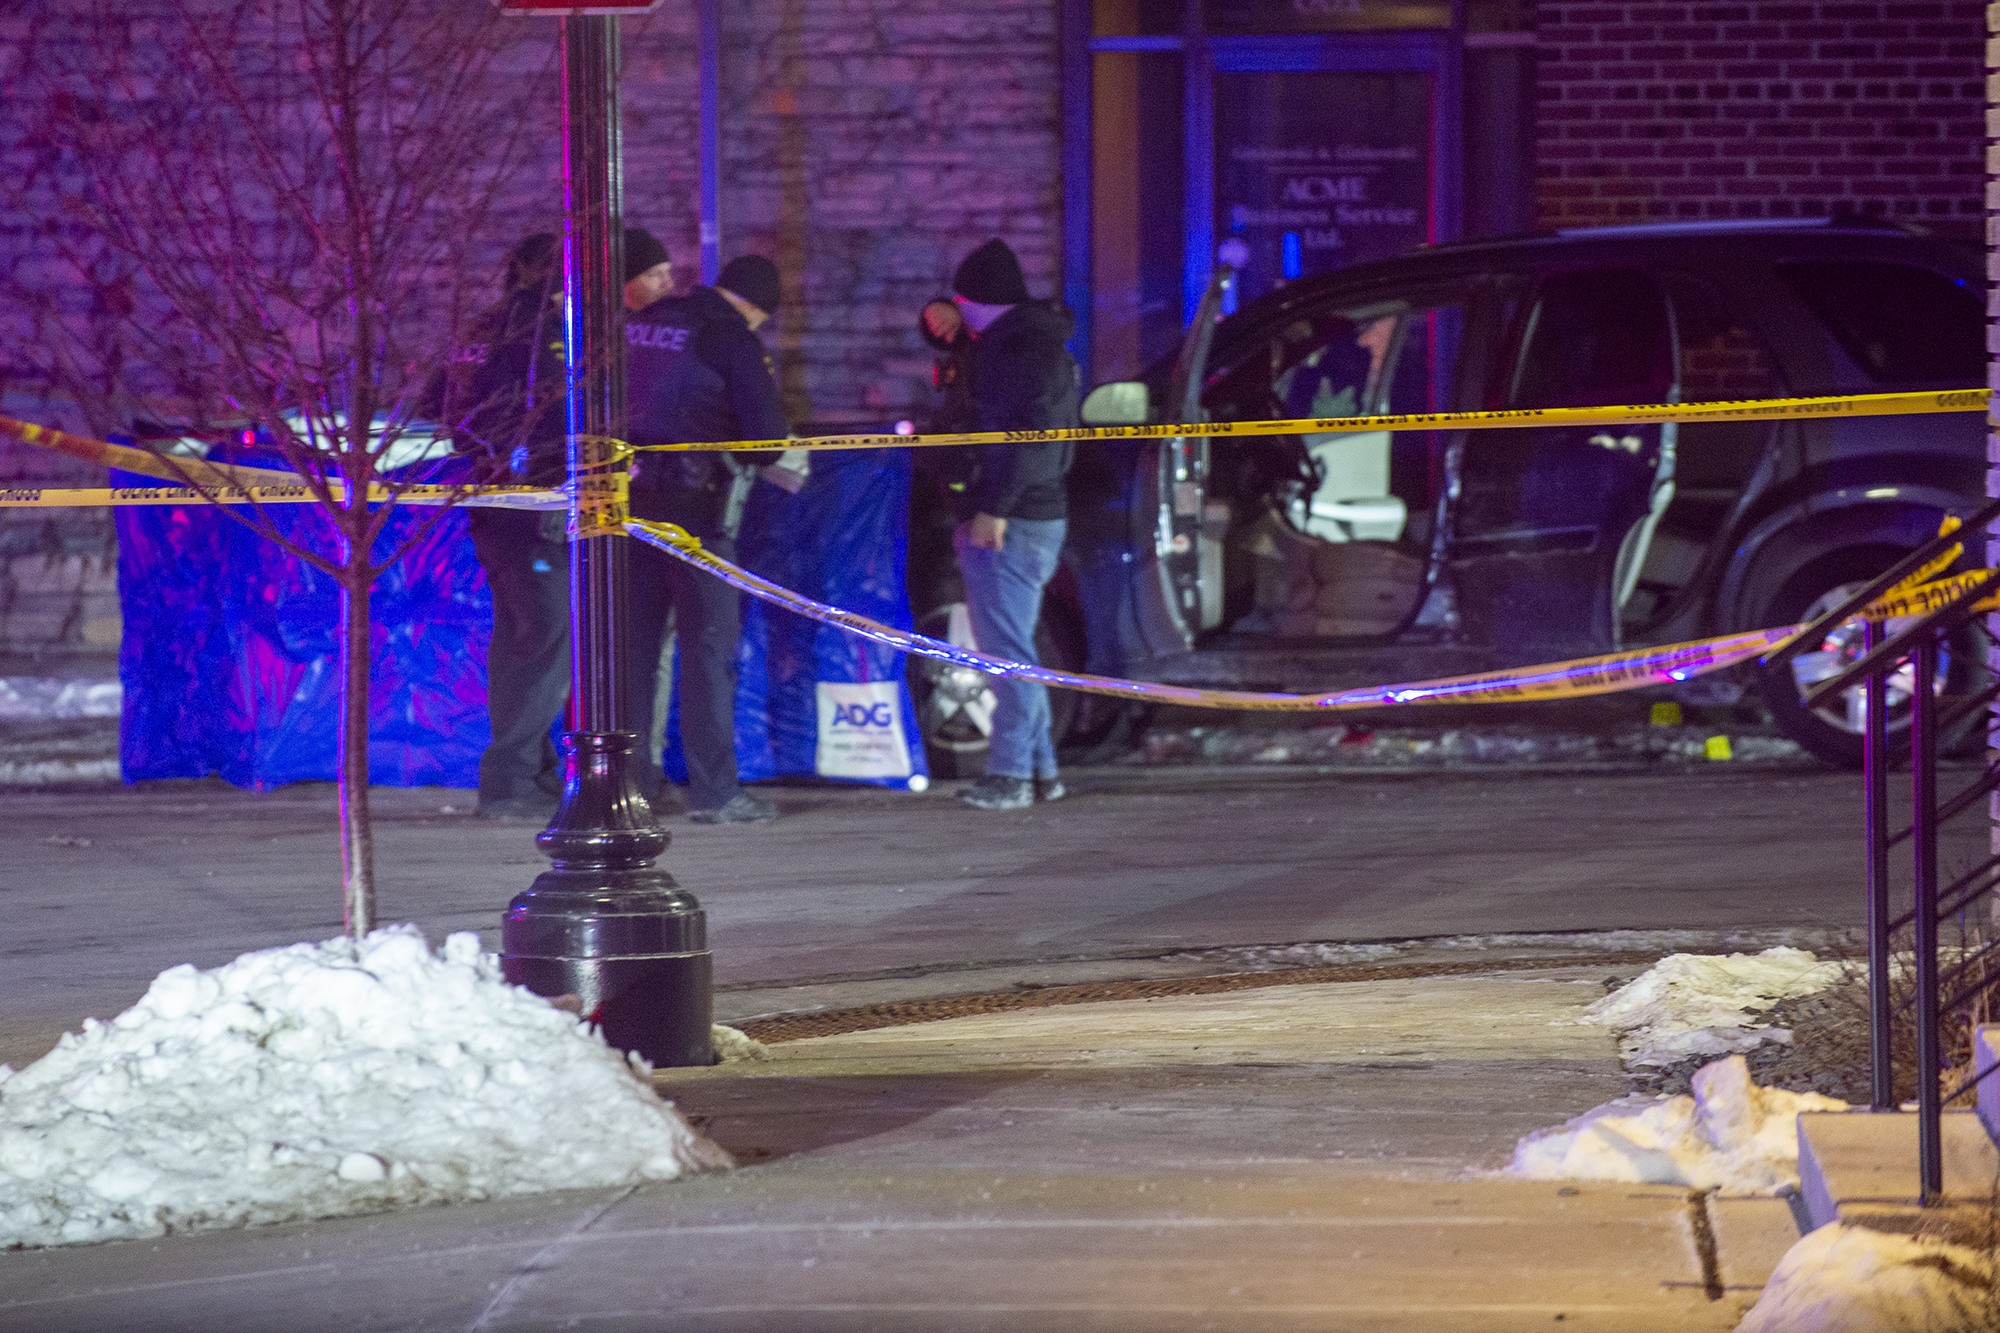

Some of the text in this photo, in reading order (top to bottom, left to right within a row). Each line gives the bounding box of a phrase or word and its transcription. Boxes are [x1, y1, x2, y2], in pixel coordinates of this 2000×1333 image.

[1283, 177, 1367, 201] ACME
[1335, 204, 1416, 226] Service
[832, 702, 892, 727] ADG
